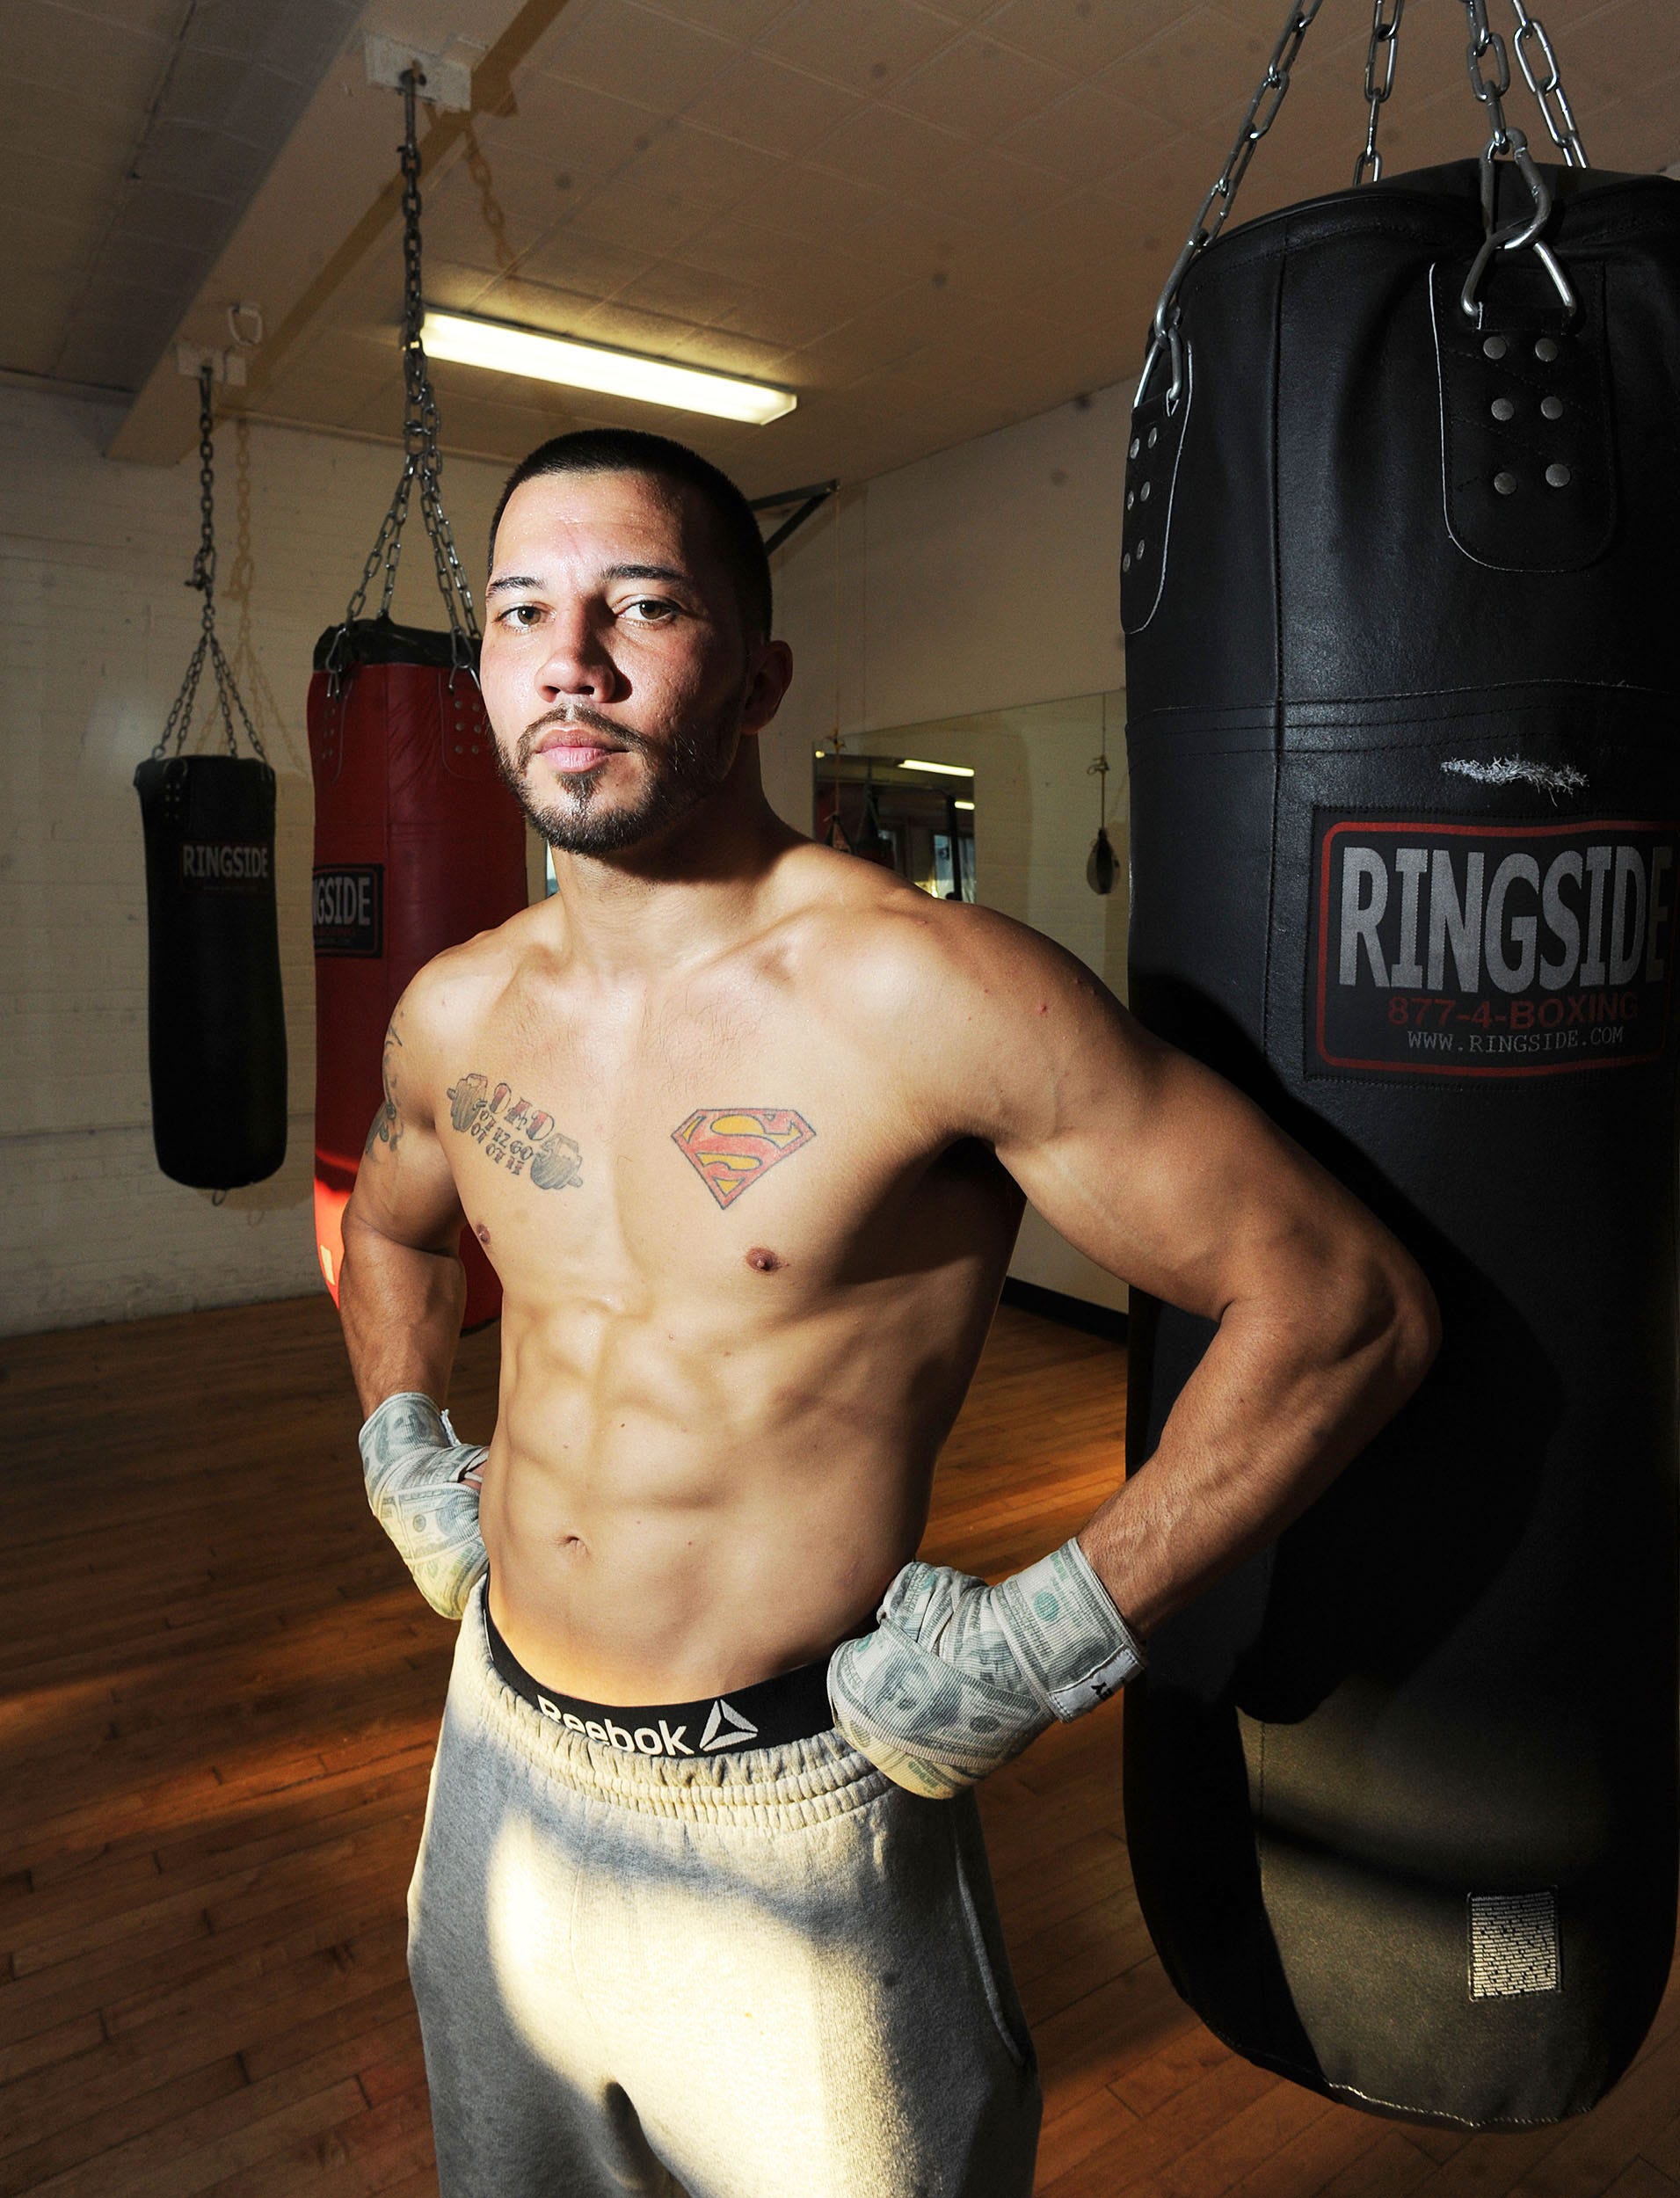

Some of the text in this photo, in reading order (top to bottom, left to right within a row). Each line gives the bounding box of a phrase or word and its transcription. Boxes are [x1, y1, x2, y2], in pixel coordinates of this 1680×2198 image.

[183, 844, 268, 878] RINGSIDE
[1339, 846, 1672, 993] RINGSIDE
[1387, 991, 1640, 1030] 877-4-BOXING
[1407, 1026, 1624, 1053] WWW.RINGSIDE.COM
[489, 1082, 555, 1140] DAD
[536, 1694, 695, 1757] Reebok
